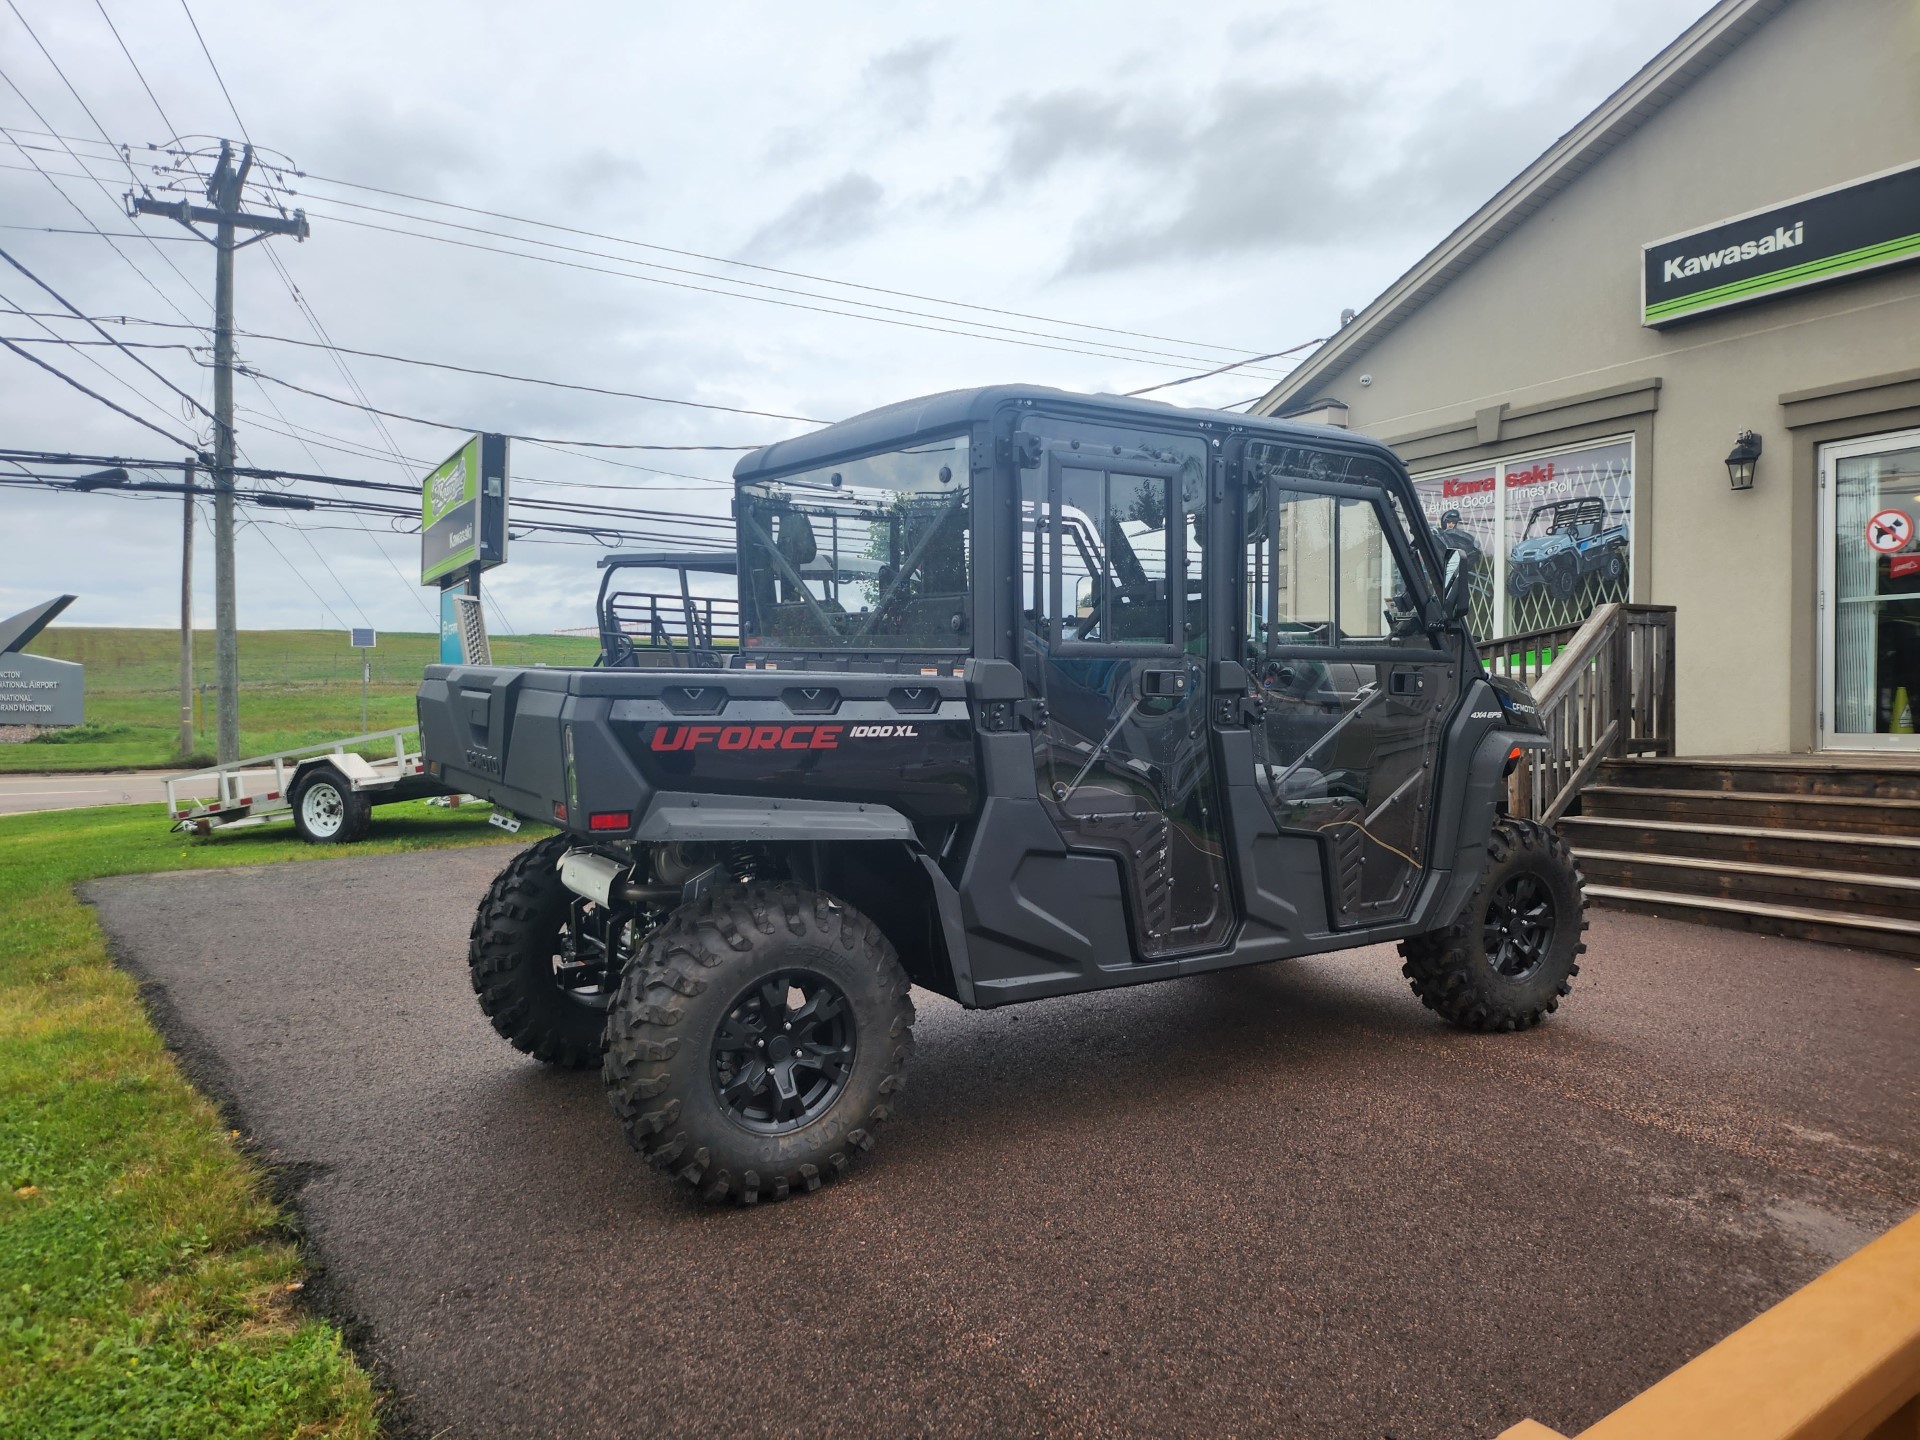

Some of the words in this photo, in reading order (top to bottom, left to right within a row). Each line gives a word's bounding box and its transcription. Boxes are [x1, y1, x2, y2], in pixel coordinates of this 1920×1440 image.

[1663, 220, 1804, 283] Kawasaki
[1423, 501, 1440, 515] Let
[1441, 498, 1460, 512] the
[1462, 493, 1493, 509] Good
[1507, 484, 1545, 502] Times
[1548, 478, 1573, 494] Roll
[449, 522, 473, 549] Kawasaki
[1471, 711, 1486, 719] 4X4
[1487, 711, 1502, 719] EPS
[1512, 702, 1536, 714] CFMOTO
[650, 725, 844, 751] UFORCE
[849, 725, 894, 738] 1000
[893, 725, 919, 737] XL
